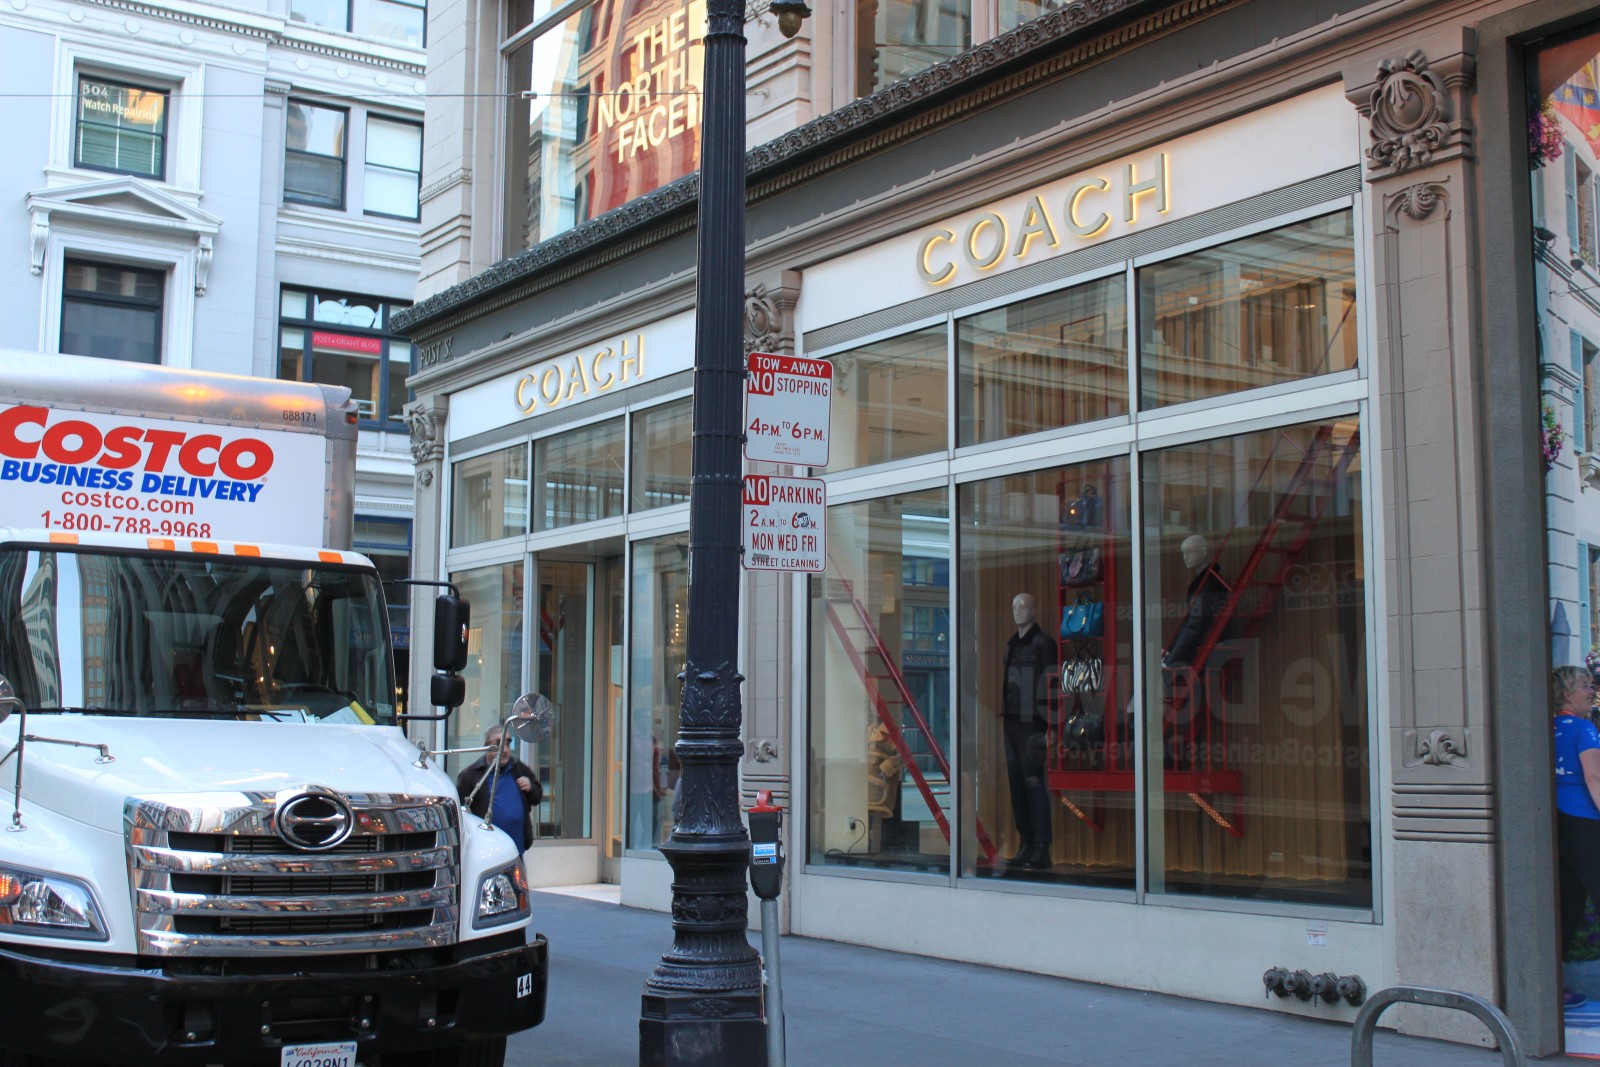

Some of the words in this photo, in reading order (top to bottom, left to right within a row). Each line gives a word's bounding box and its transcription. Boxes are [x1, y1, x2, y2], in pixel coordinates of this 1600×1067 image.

[634, 8, 686, 70] THE
[598, 51, 686, 134] NORTH
[84, 98, 111, 113] Watch
[113, 103, 158, 123] Repairing
[618, 94, 685, 164] FACE
[916, 153, 1170, 285] COACH
[420, 340, 443, 369] POST
[514, 333, 645, 415] COACH
[749, 371, 773, 393] NO
[777, 377, 828, 397] STOPPING
[282, 410, 316, 423] 688171
[782, 421, 791, 430] TO
[0, 405, 274, 480] COSTCO
[1, 459, 134, 492] BUSINESS
[141, 473, 265, 503] DELIVERY
[746, 477, 768, 503] NO
[771, 485, 822, 505] PARKING
[61, 491, 195, 515] costco.com
[41, 510, 211, 539] 1-800-788-9968
[752, 532, 774, 551] MON
[778, 534, 798, 552] WED
[801, 534, 817, 553] FRI
[752, 555, 779, 567] STREET
[781, 558, 820, 569] CLEANING
[519, 974, 531, 996] 44
[296, 1046, 342, 1058] California
